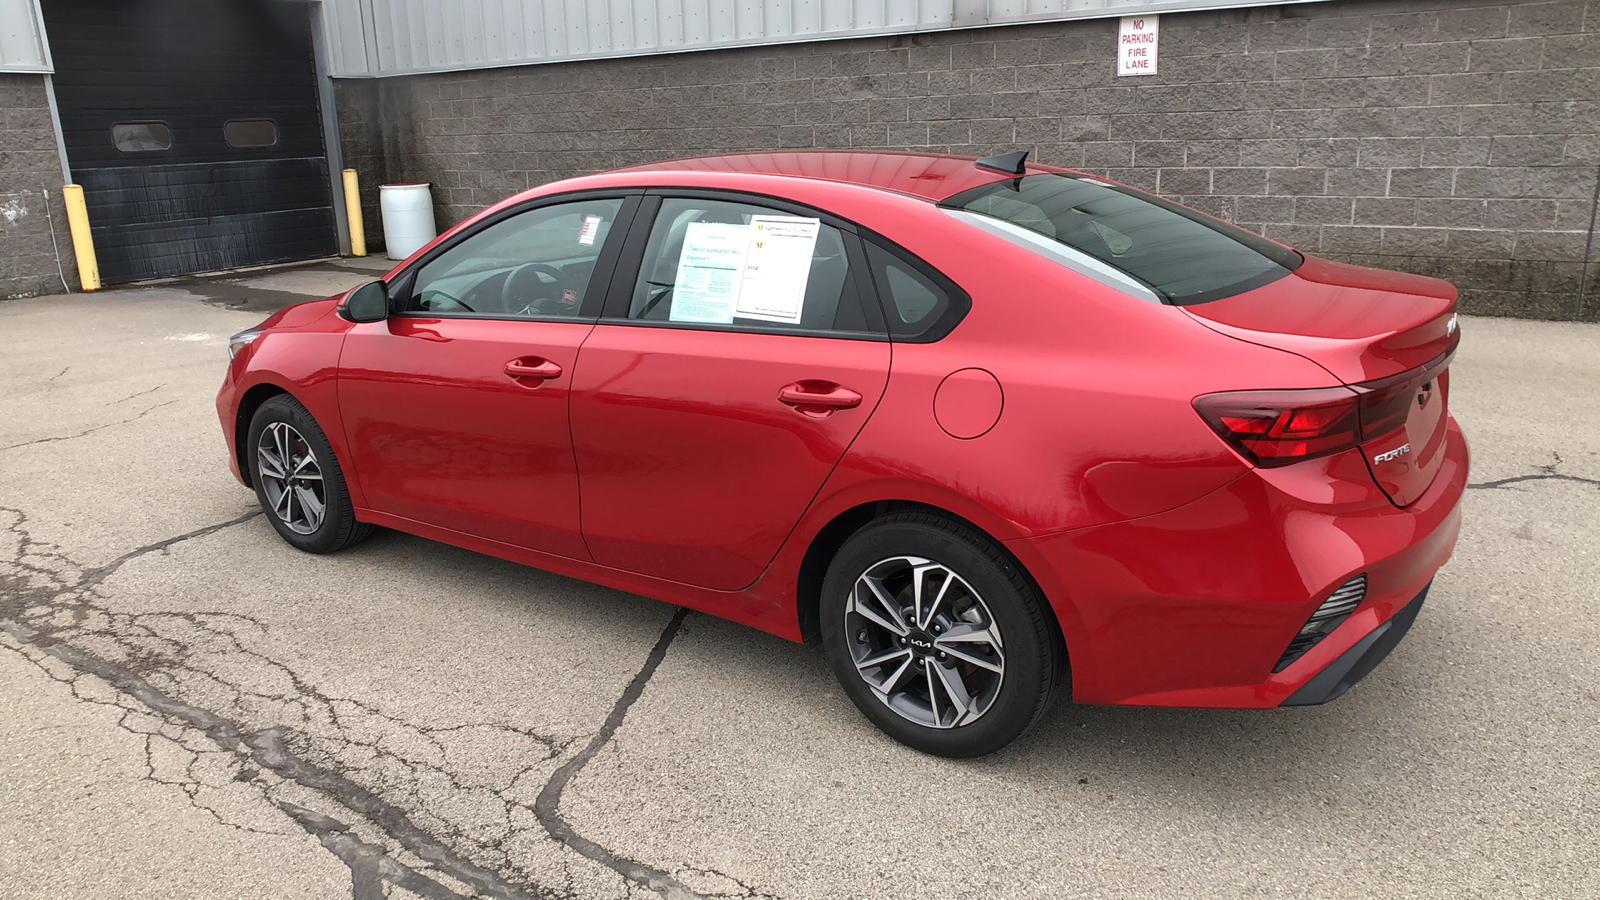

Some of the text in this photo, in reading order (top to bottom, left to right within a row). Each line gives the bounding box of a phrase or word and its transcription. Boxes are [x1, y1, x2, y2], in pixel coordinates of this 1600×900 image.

[1133, 19, 1144, 30] NO
[1122, 33, 1154, 44] PARKING
[1128, 48, 1147, 57] FIRE
[1126, 60, 1149, 69] LANE
[1374, 442, 1410, 466] FORTE
